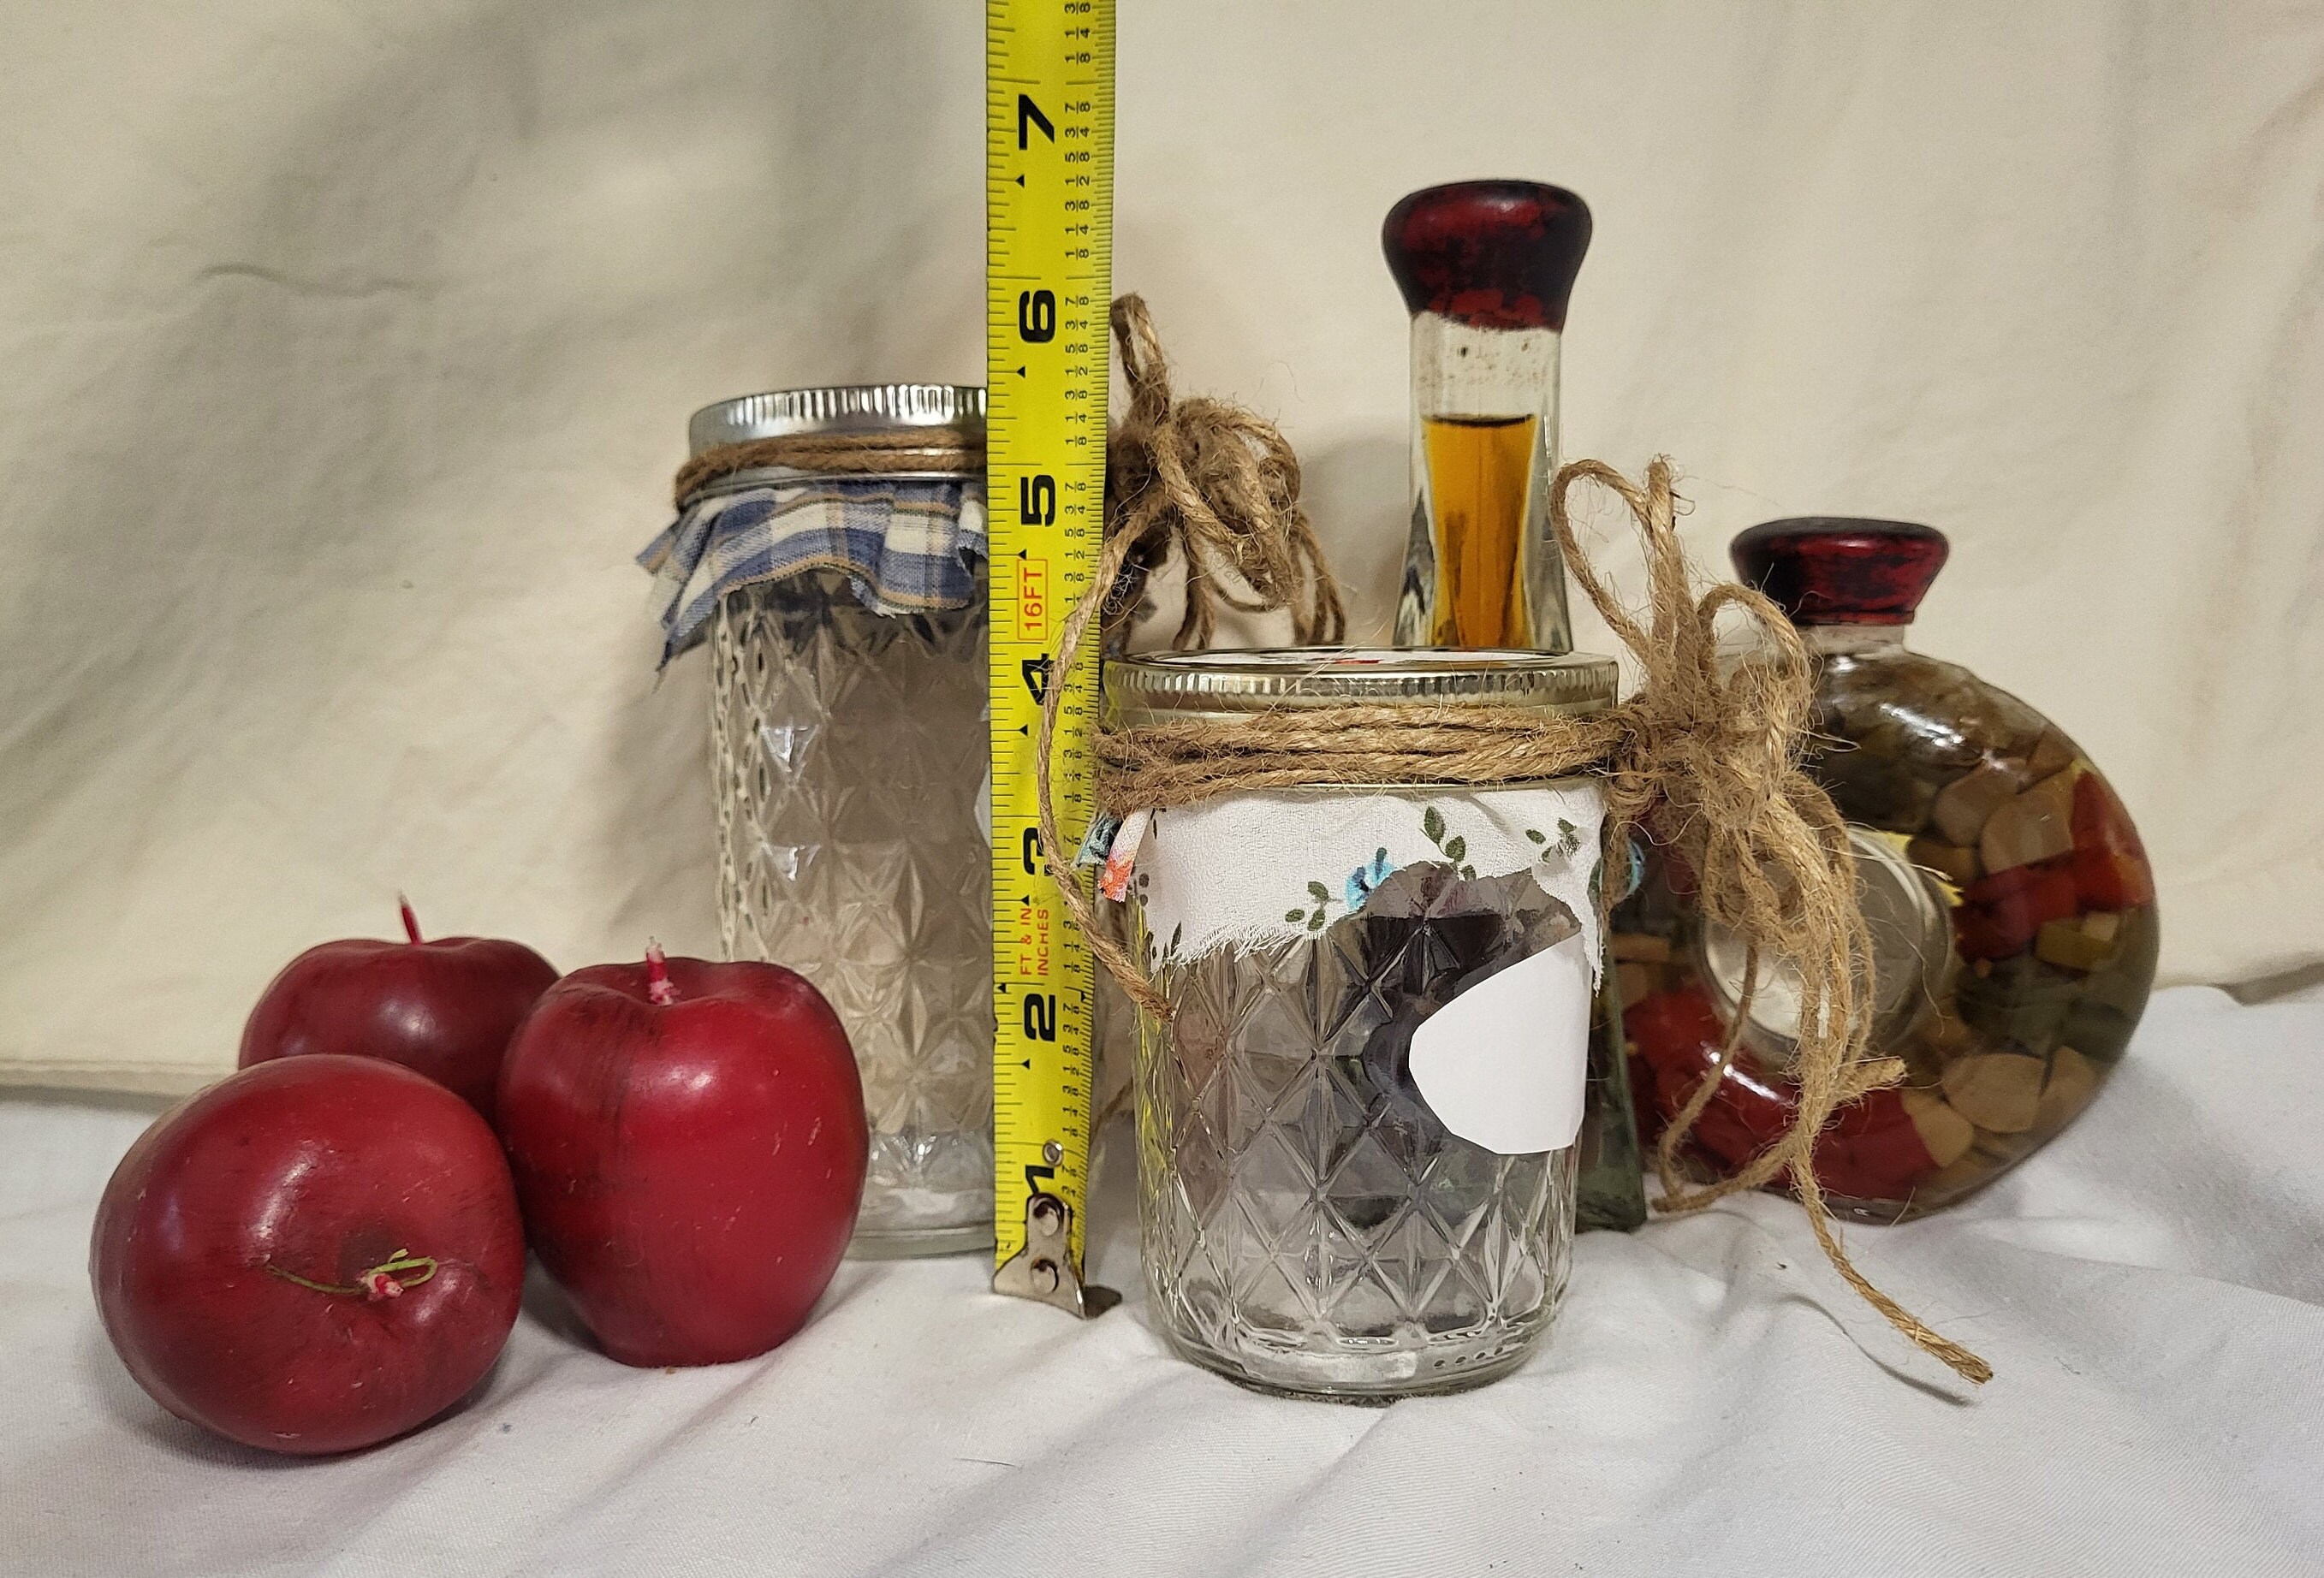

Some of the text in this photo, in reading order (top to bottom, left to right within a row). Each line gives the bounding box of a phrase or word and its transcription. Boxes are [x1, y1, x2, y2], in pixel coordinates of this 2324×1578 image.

[1018, 94, 1055, 151] 7
[1019, 290, 1055, 343] 6
[1020, 475, 1055, 527] 5
[1023, 567, 1043, 631] 16FT
[1022, 653, 1055, 705] 4
[1020, 908, 1031, 976] FT & IN
[1037, 909, 1049, 976] INCHES
[1024, 994, 1055, 1041] 2
[1025, 1165, 1054, 1194] 1
